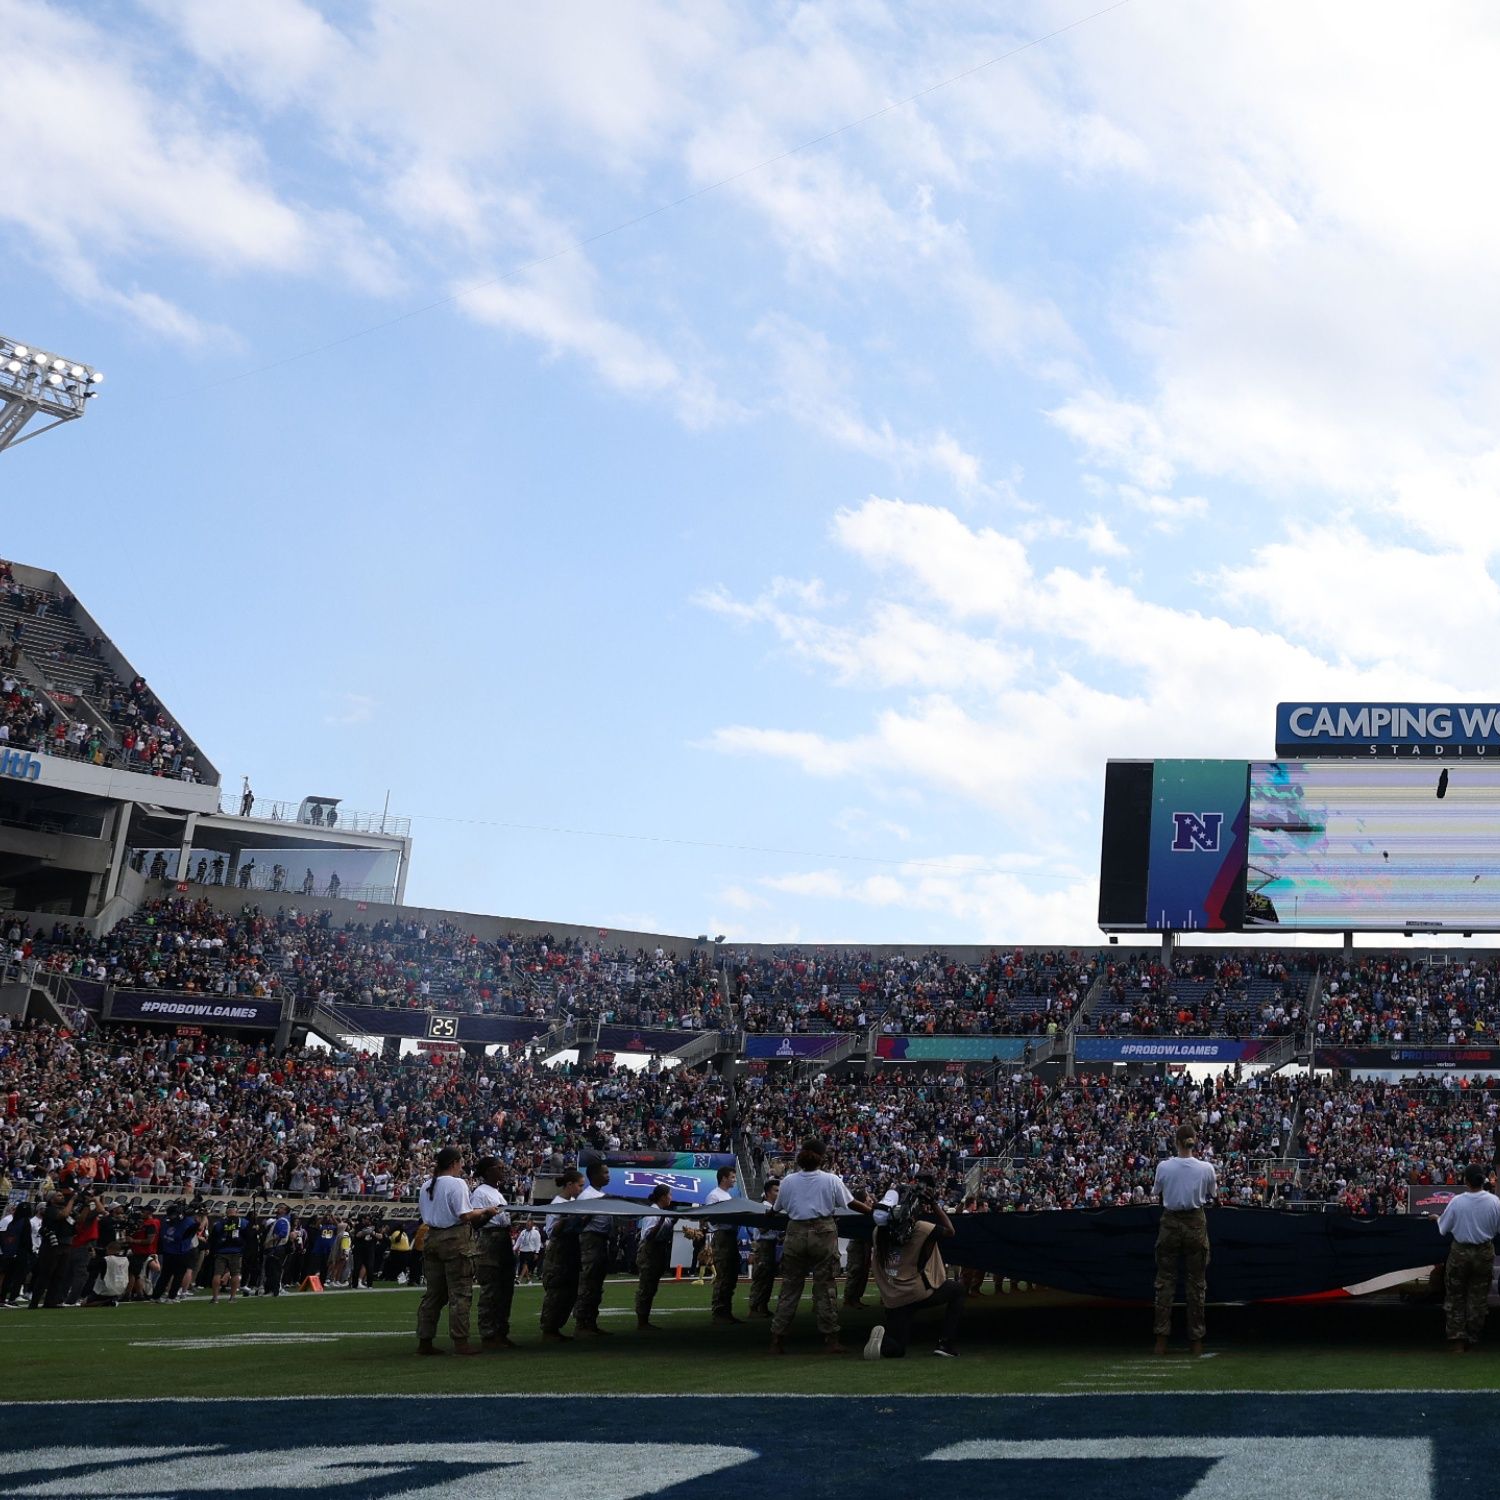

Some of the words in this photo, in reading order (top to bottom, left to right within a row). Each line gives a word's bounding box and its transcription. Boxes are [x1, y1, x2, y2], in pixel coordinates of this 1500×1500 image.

[1289, 707, 1453, 737] CAMPING
[1171, 811, 1224, 852] N
[141, 1001, 258, 1018] #PROBOWLGAMES
[432, 1018, 454, 1036] 25
[1120, 1045, 1220, 1056] #PROBOWLGAMES
[1401, 1050, 1422, 1060] PRO
[1455, 1050, 1491, 1060] GAMES
[692, 1153, 711, 1168] N
